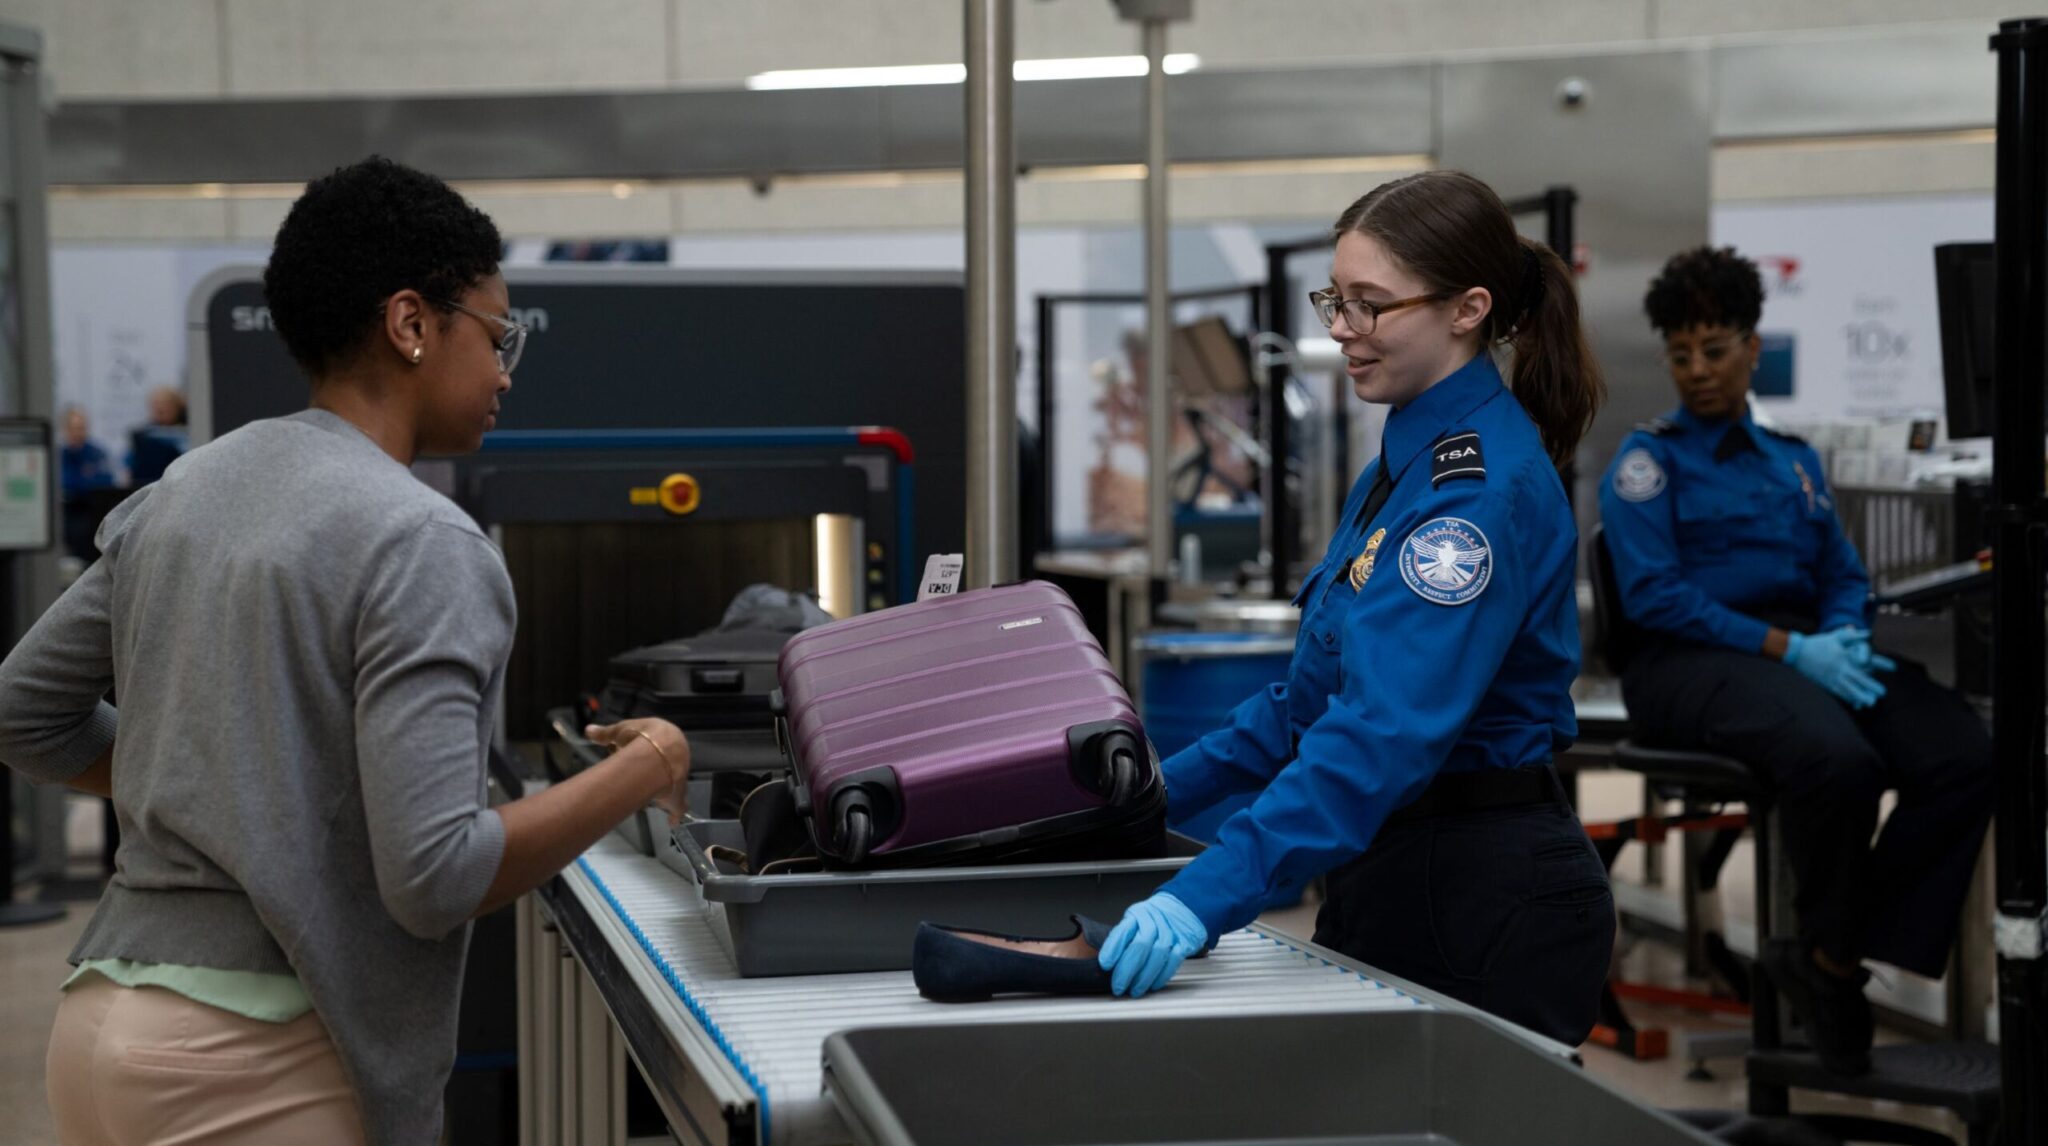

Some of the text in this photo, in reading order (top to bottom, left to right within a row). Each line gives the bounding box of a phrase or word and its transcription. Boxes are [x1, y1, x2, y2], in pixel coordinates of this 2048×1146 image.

[1435, 446, 1477, 461] TSA
[1445, 520, 1460, 528] TSA
[928, 583, 952, 593] DCA
